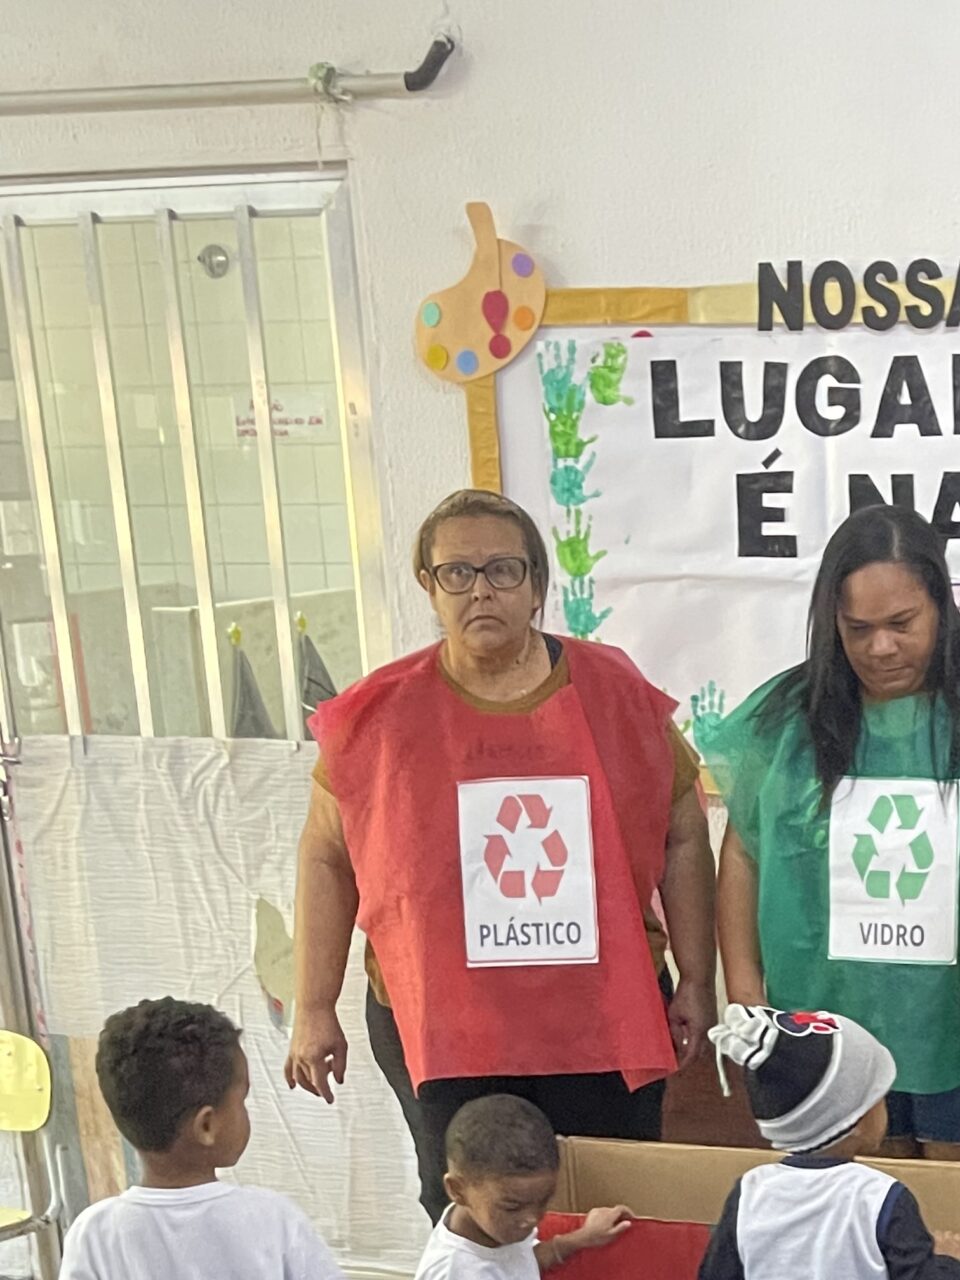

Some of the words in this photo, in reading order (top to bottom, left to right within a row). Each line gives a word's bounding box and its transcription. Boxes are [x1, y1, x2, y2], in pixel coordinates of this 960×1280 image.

[736, 448, 798, 558] É
[479, 916, 582, 947] PLÁSTICO
[859, 922, 925, 947] VIDRO
